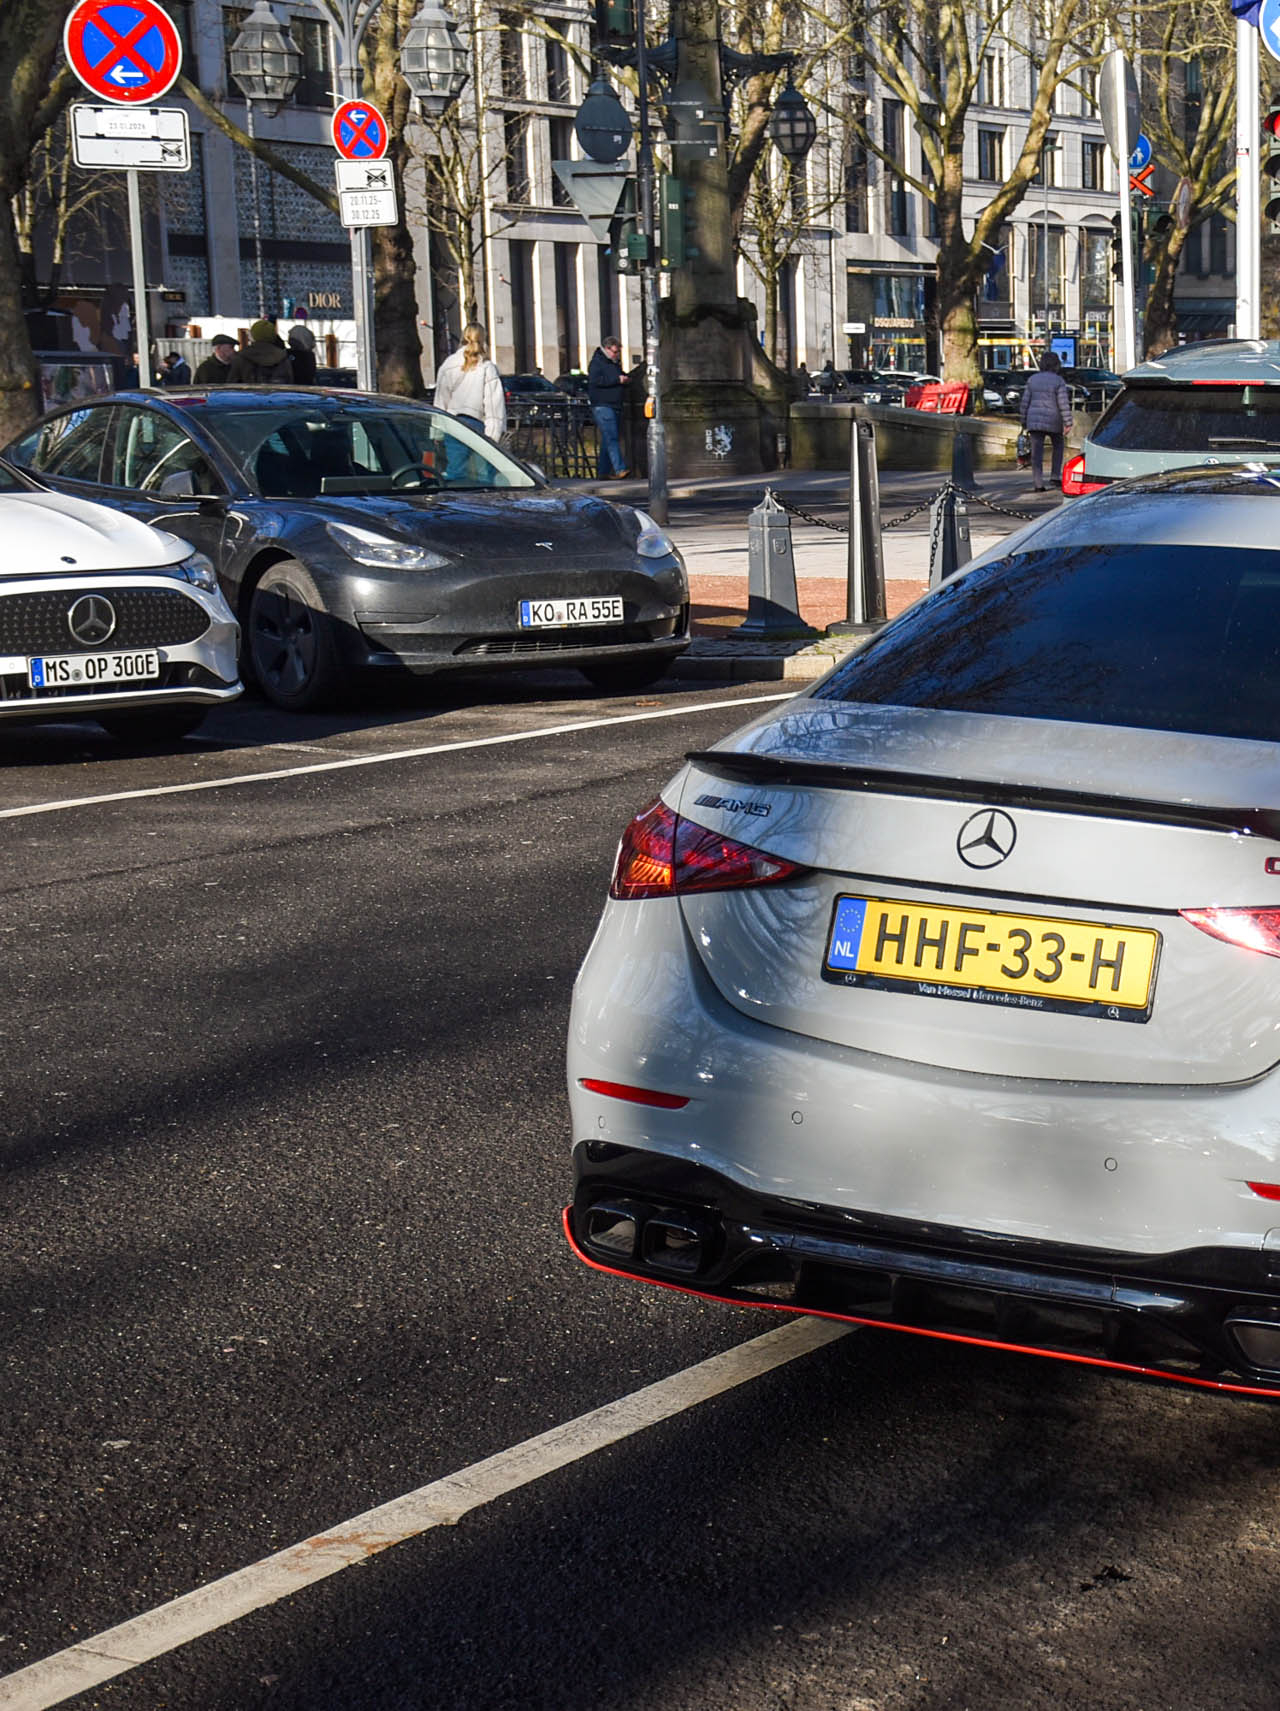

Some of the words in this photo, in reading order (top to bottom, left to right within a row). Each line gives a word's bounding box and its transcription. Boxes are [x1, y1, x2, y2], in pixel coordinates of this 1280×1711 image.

[308, 293, 342, 309] DIOR
[532, 604, 555, 623] KO
[566, 602, 588, 621] RA
[591, 600, 622, 619] 55E
[45, 660, 70, 682] MS
[85, 658, 108, 679] OP
[112, 654, 156, 677] 300E
[717, 797, 772, 817] AMG
[834, 940, 854, 958] NL
[874, 912, 1126, 992] HHF-33-H
[918, 982, 937, 995] Van
[937, 985, 971, 999] Mossel
[972, 990, 1043, 1008] Mercedes-Benz
